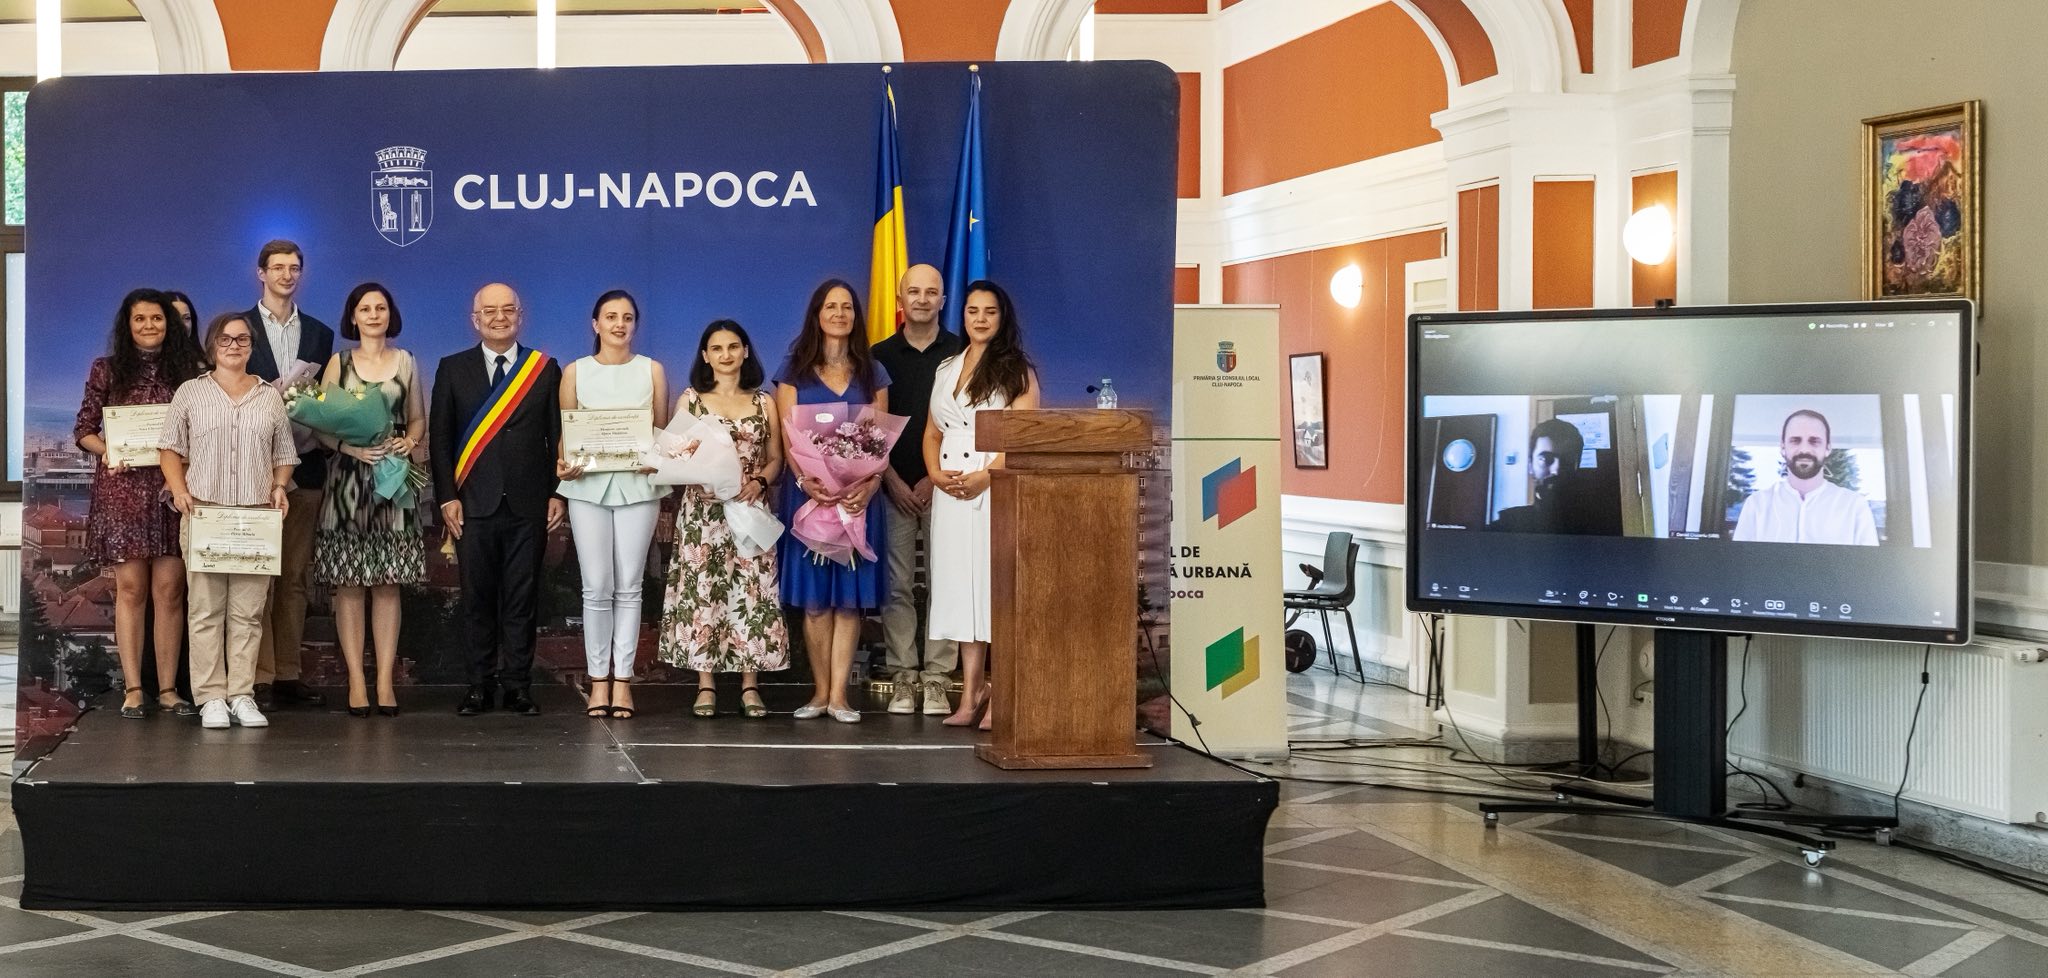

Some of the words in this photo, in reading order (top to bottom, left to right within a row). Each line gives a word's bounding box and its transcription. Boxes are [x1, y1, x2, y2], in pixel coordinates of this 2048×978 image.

[454, 171, 817, 210] CLUJ-NAPOCA
[1181, 546, 1200, 558] DE
[1183, 563, 1252, 578] URBANĂ
